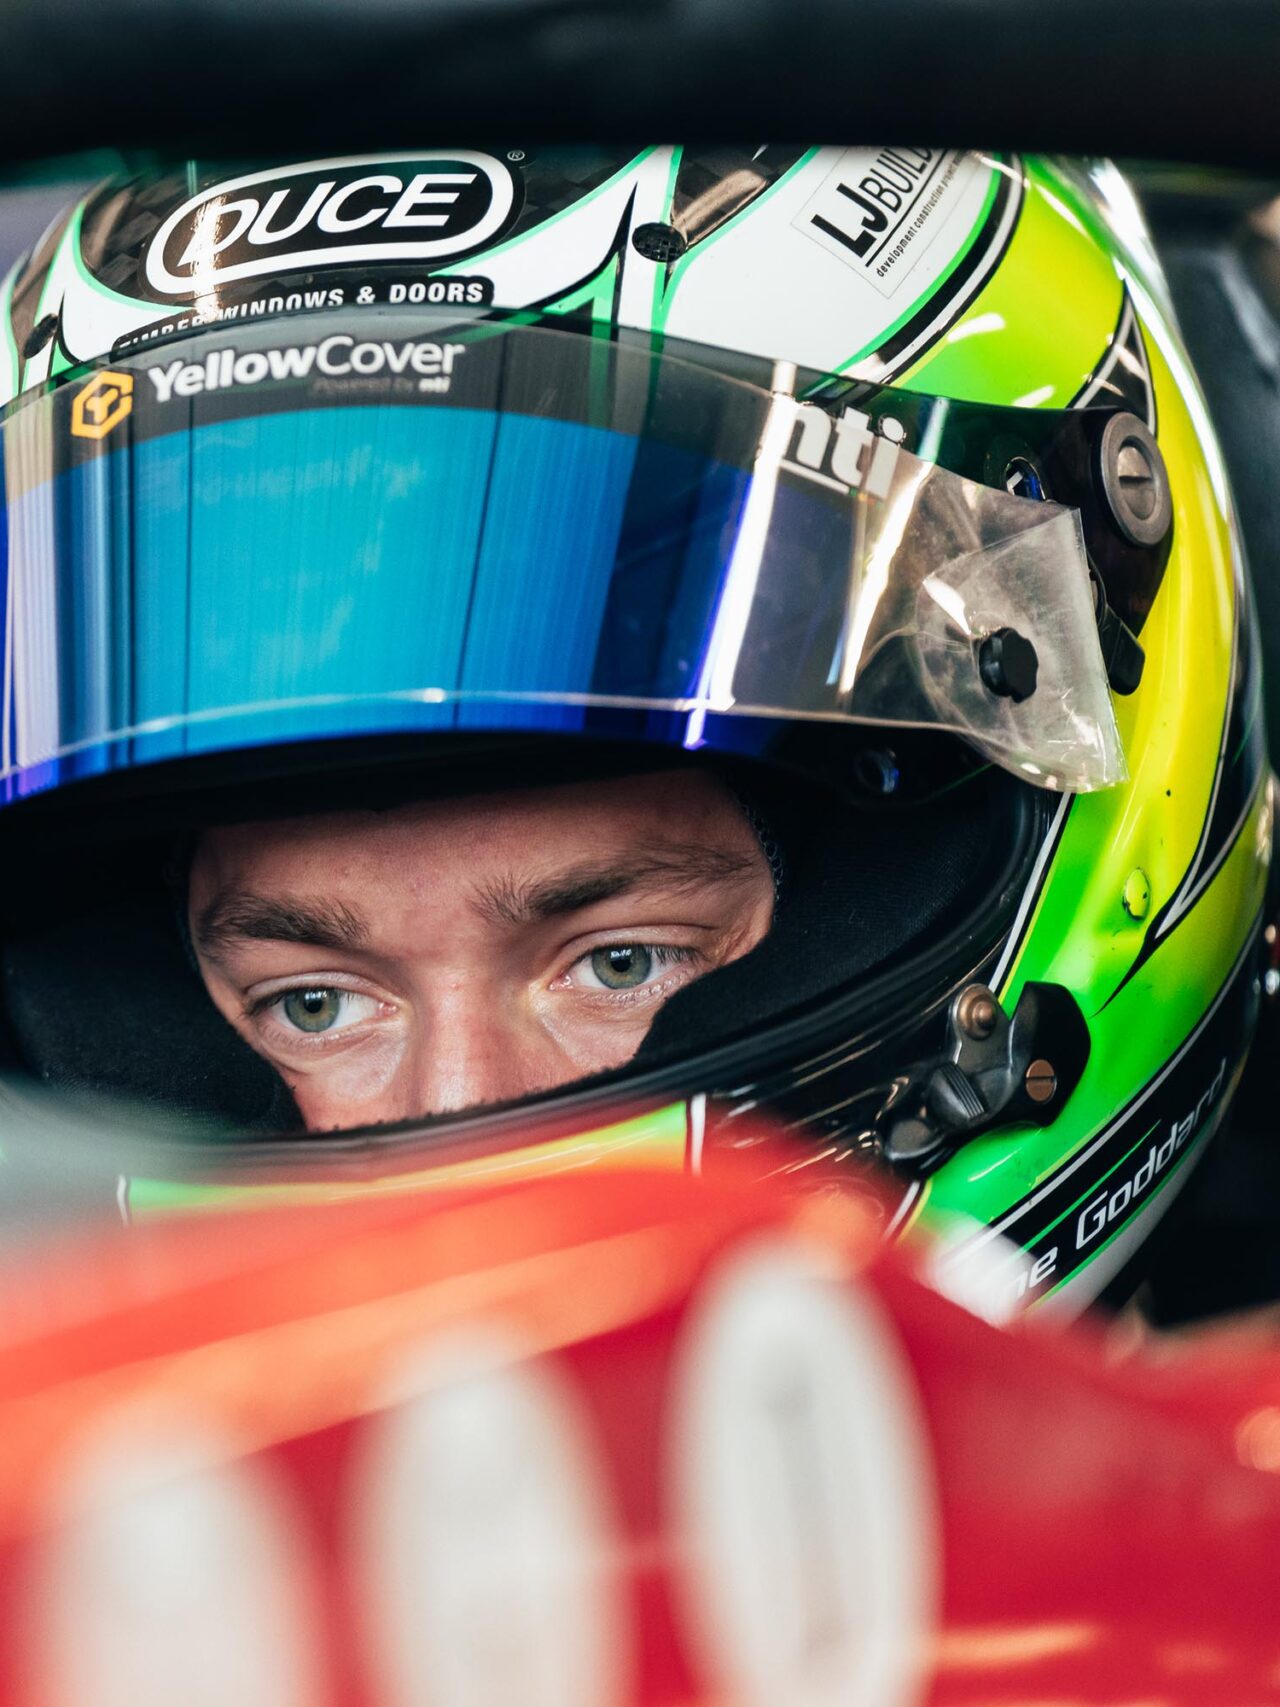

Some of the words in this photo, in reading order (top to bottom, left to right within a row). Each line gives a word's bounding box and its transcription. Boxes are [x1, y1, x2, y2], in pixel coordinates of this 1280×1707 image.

[177, 172, 478, 268] DUCE
[876, 226, 918, 278] development
[355, 285, 376, 305] &
[388, 282, 484, 304] DOORS
[148, 335, 466, 402] YellowCover
[1075, 1056, 1228, 1250] Goddard
